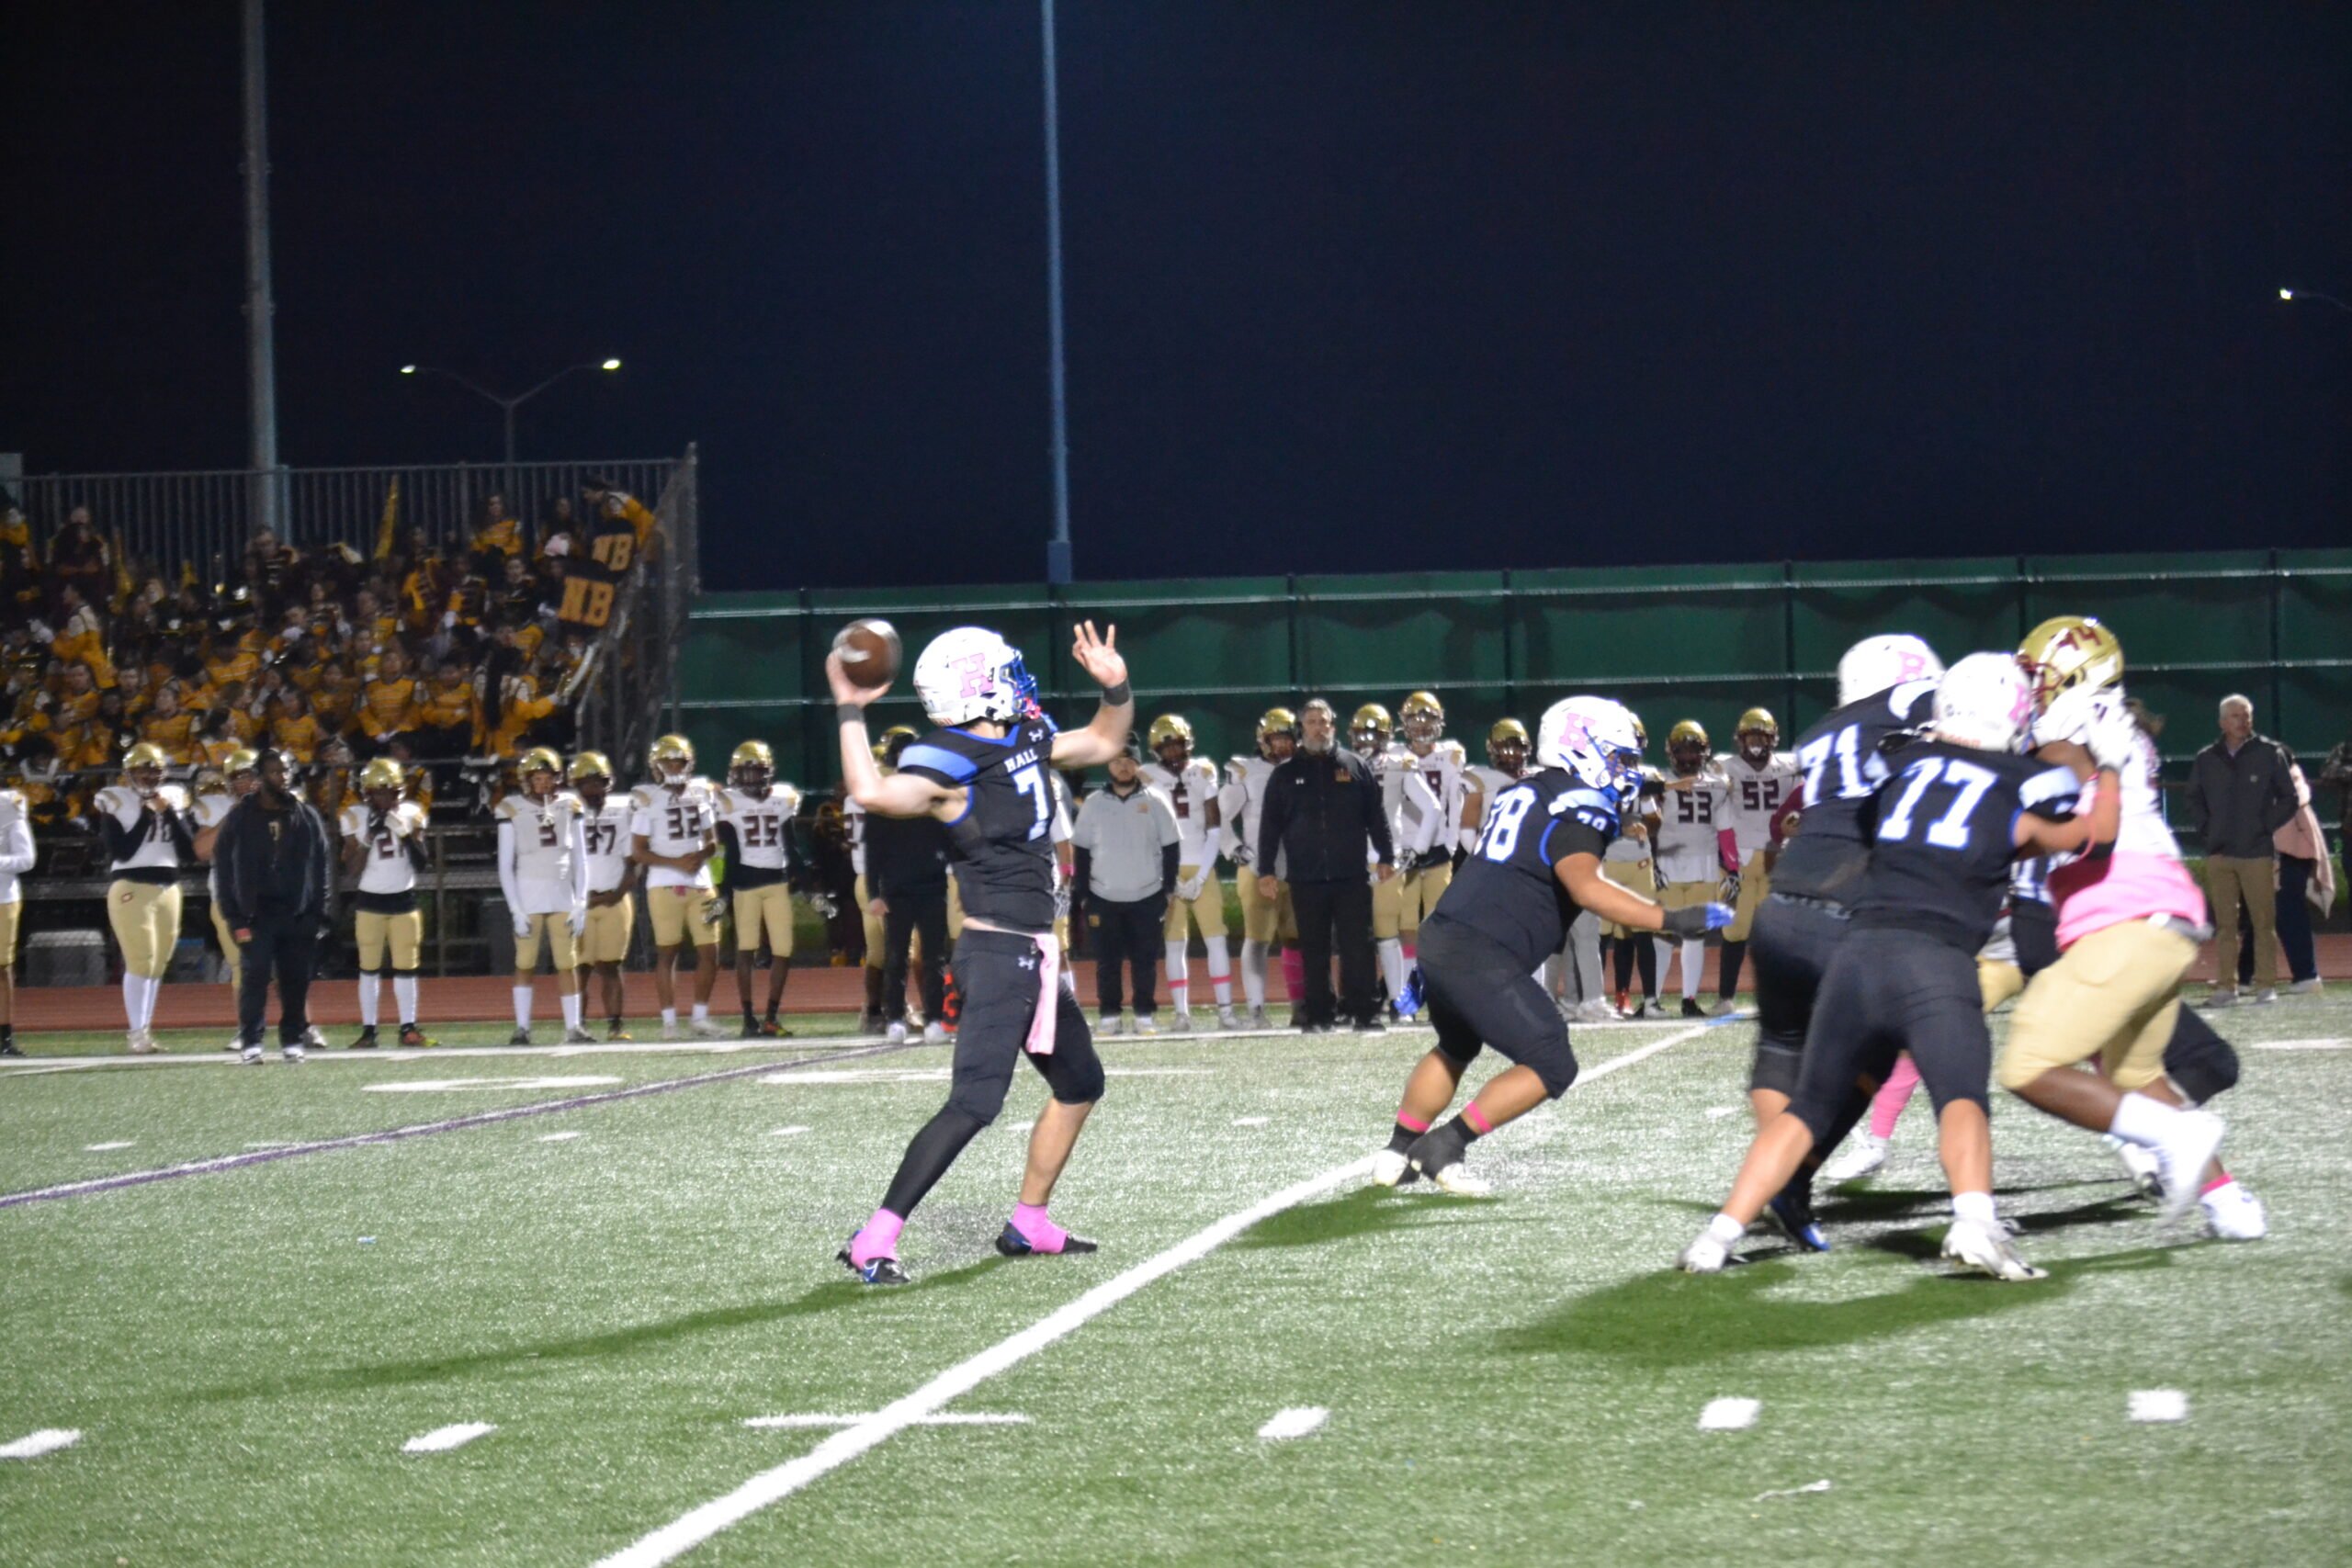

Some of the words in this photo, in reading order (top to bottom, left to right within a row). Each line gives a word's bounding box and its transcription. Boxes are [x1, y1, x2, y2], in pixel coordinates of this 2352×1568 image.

[558, 576, 615, 627] NB
[951, 652, 994, 698] H
[1558, 712, 1597, 751] H
[1004, 748, 1038, 773] HALL
[1798, 722, 1872, 806] 71
[1012, 761, 1049, 841] 7
[1676, 790, 1713, 824] 53
[1741, 779, 1780, 811] 52
[1877, 756, 1999, 850] 77
[666, 805, 701, 840] 32
[742, 815, 779, 847] 25
[1473, 784, 1537, 863] 78
